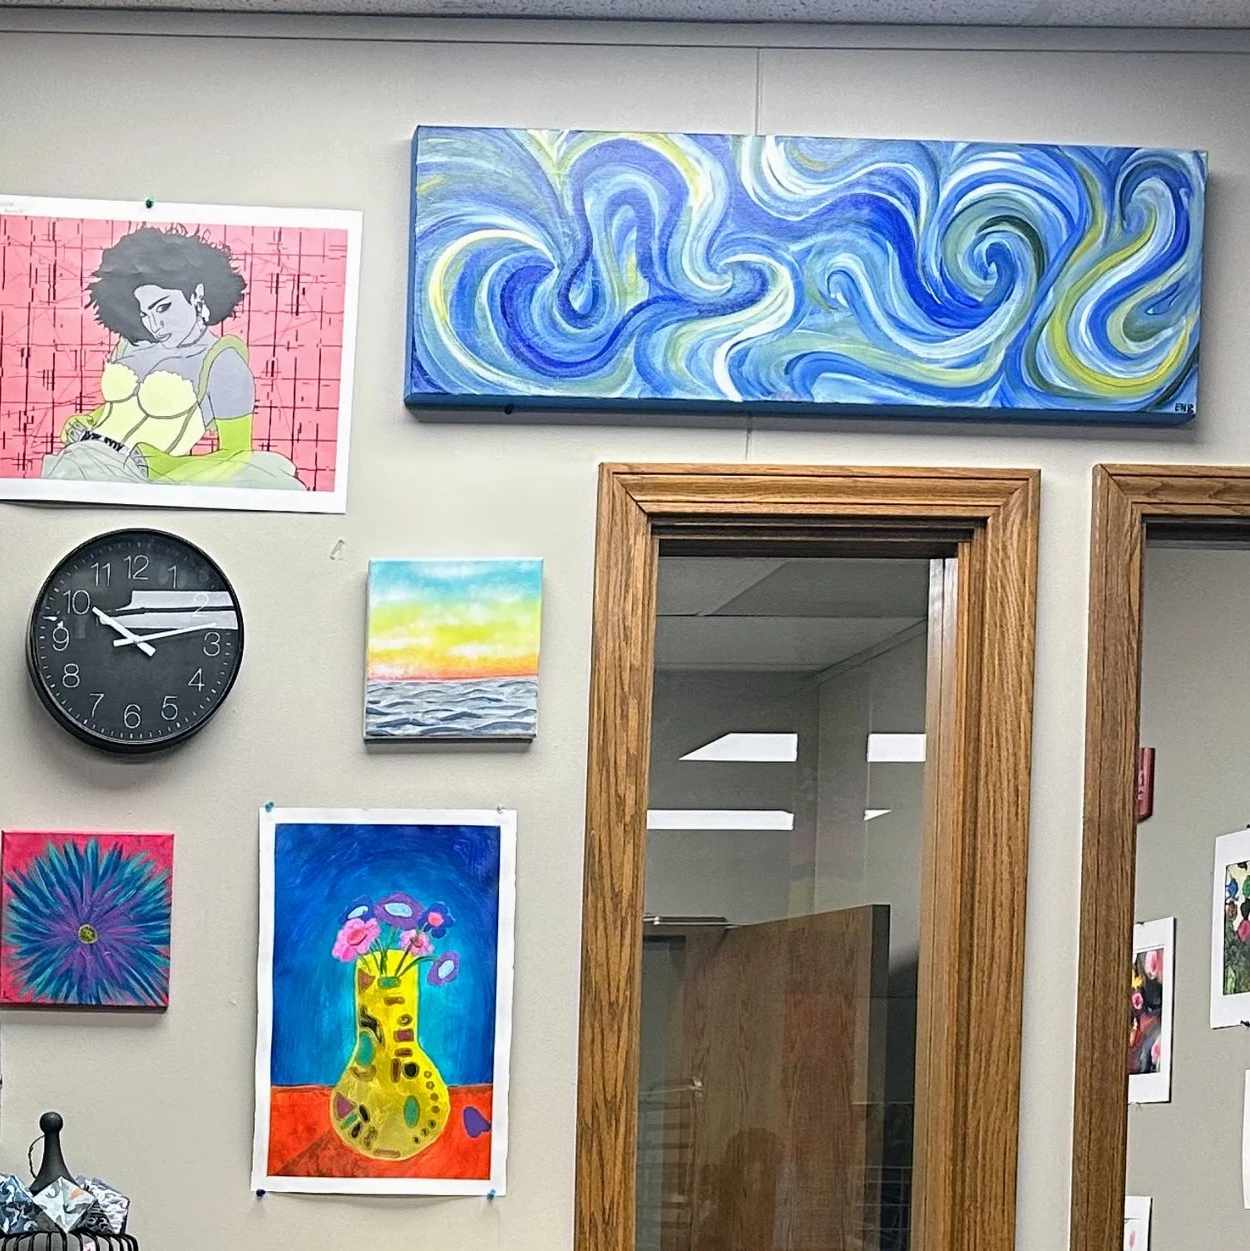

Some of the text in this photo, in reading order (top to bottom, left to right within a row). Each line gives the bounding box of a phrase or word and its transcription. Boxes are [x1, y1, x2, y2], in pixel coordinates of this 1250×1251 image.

[90, 562, 111, 587] 11
[123, 554, 150, 581] 12
[166, 564, 178, 589] 1
[63, 589, 91, 615] 10
[192, 592, 211, 618] 2
[52, 626, 70, 651] 9
[203, 631, 221, 657] 3
[62, 663, 81, 689] 8
[187, 667, 205, 692] 4
[89, 693, 105, 719] 7
[123, 704, 141, 729] 6
[160, 695, 179, 721] 5
